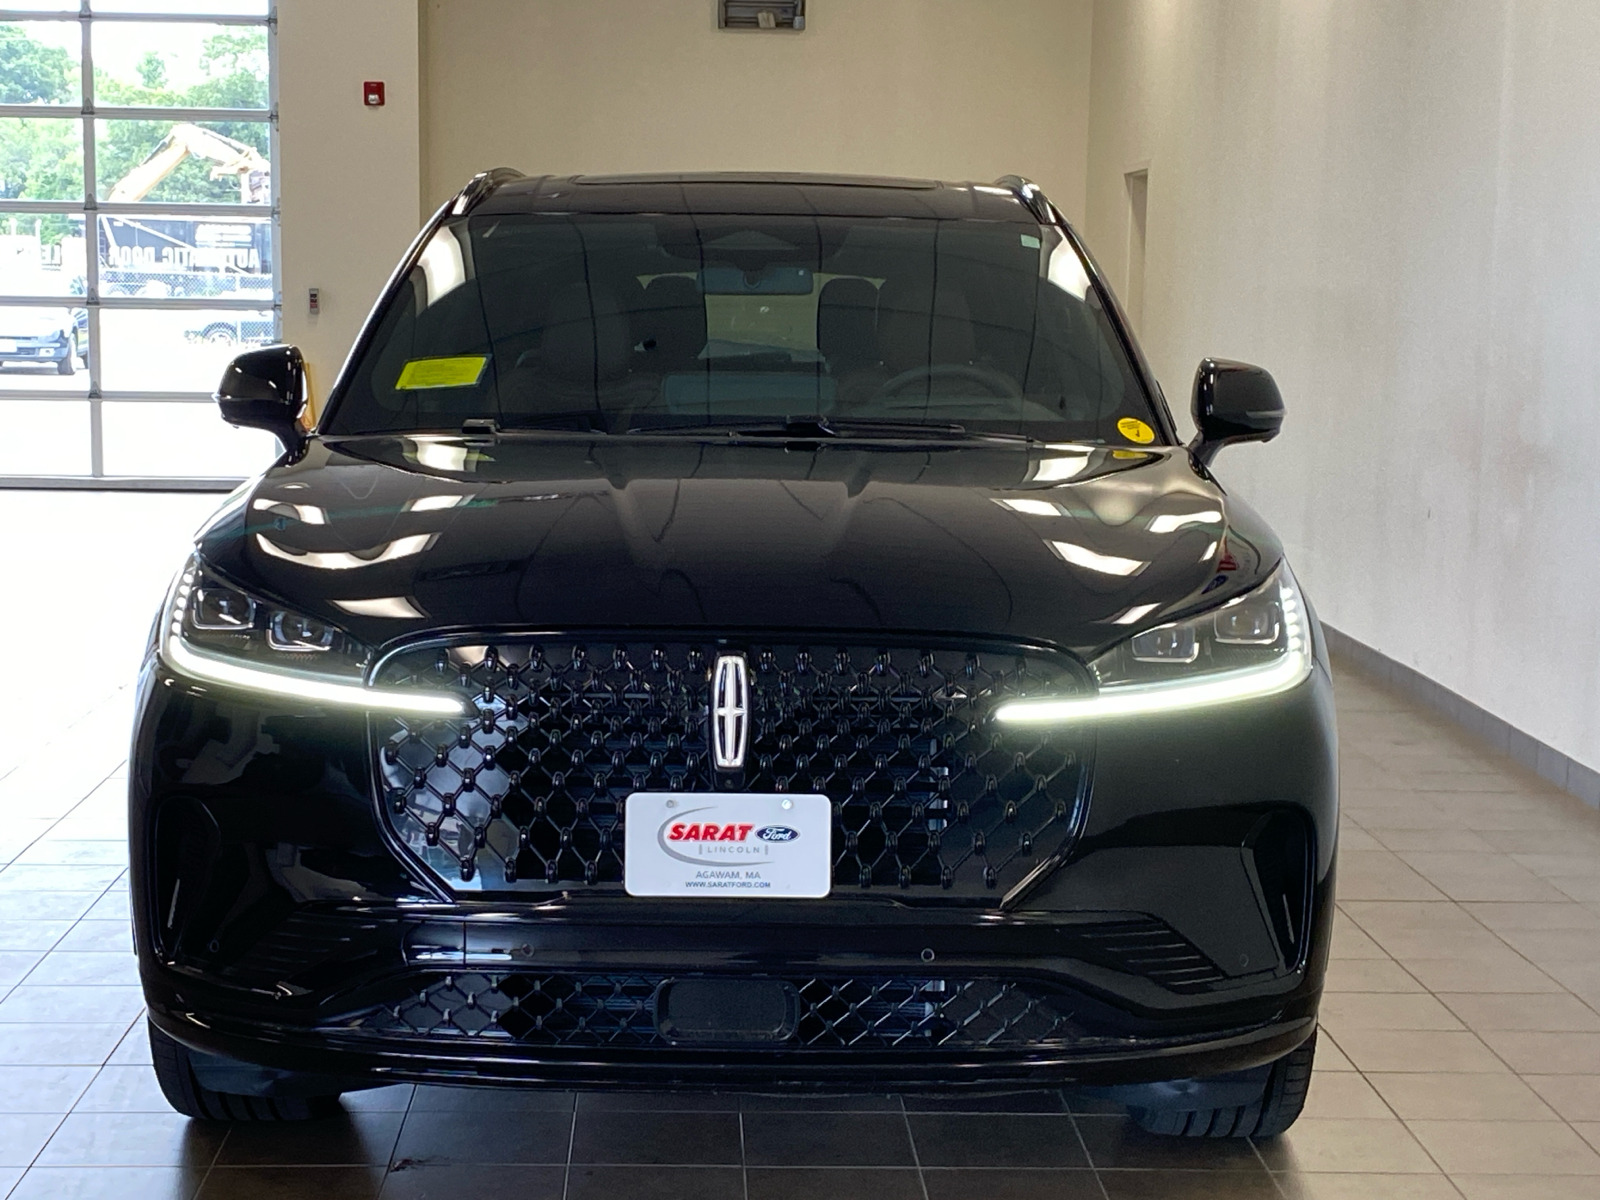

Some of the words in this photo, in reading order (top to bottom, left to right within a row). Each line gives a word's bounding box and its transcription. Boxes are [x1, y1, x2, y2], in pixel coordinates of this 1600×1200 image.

[668, 823, 754, 841] SARAT
[763, 827, 792, 841] Ford
[707, 845, 760, 854] LINCOLN
[695, 870, 743, 880] AGAWAM,
[745, 871, 762, 880] MA
[685, 881, 771, 889] WWW.SARATFORD.COM
